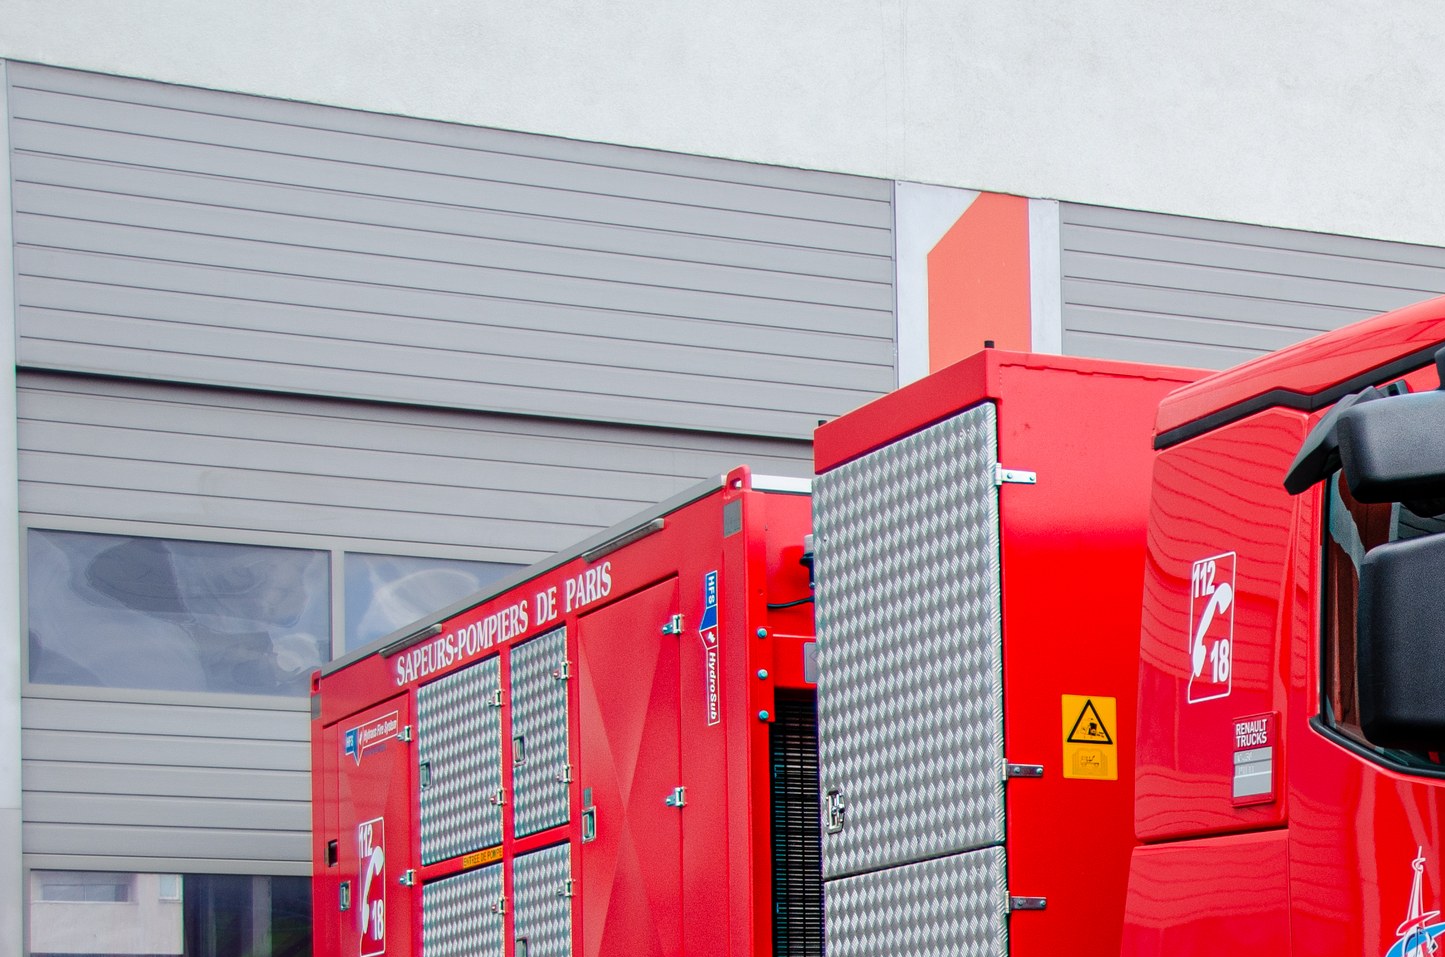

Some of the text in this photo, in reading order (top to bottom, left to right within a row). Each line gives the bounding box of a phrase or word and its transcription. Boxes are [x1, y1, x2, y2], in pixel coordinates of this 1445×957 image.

[1193, 561, 1216, 598] 112
[396, 561, 612, 686] SAPEURS-POMPIERS DE PARIS
[1210, 639, 1229, 683] 18
[709, 651, 717, 720] HydroSub
[1235, 719, 1268, 736] RENAULT
[1236, 732, 1267, 748] TRUCKS
[360, 823, 373, 859] 112
[372, 898, 384, 941] 18
